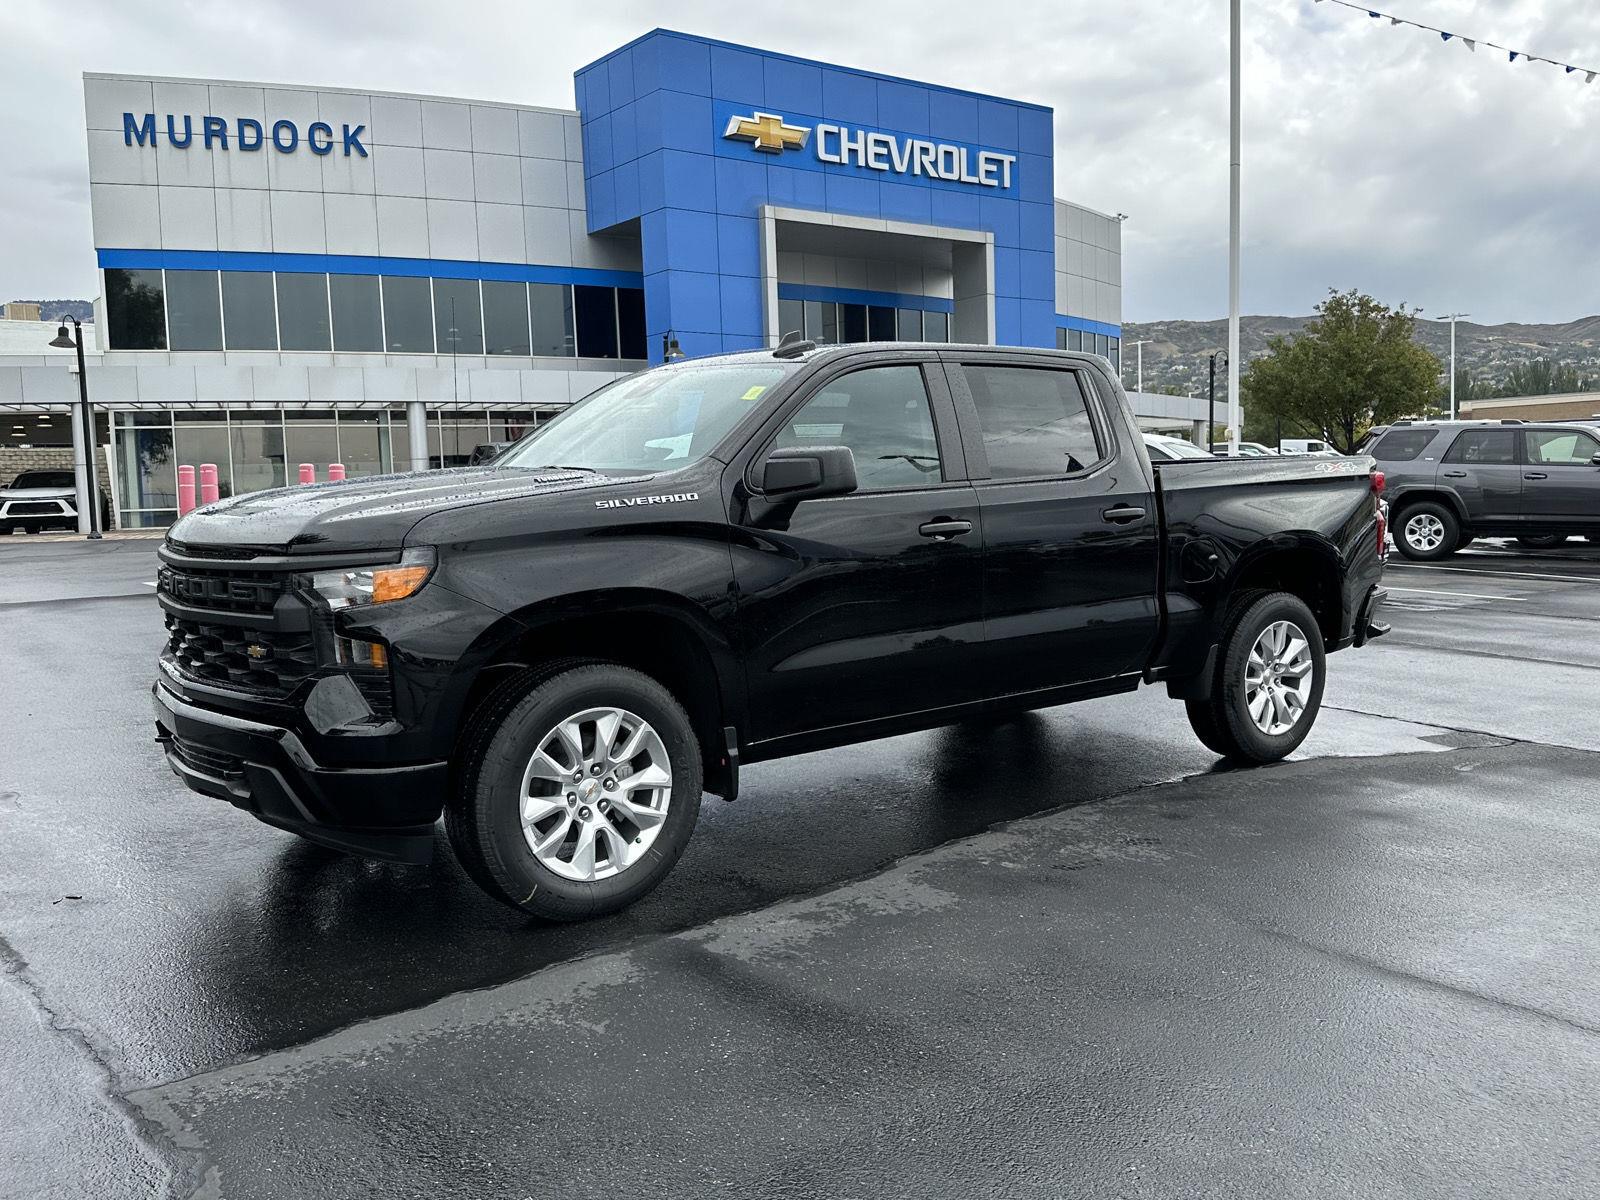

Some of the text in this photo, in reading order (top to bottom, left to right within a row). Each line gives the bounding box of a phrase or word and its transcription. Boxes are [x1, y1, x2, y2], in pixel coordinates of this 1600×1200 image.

[123, 112, 369, 157] MURDOCK
[816, 123, 1016, 188] CHEVROLET
[595, 492, 699, 509] SILVERADO
